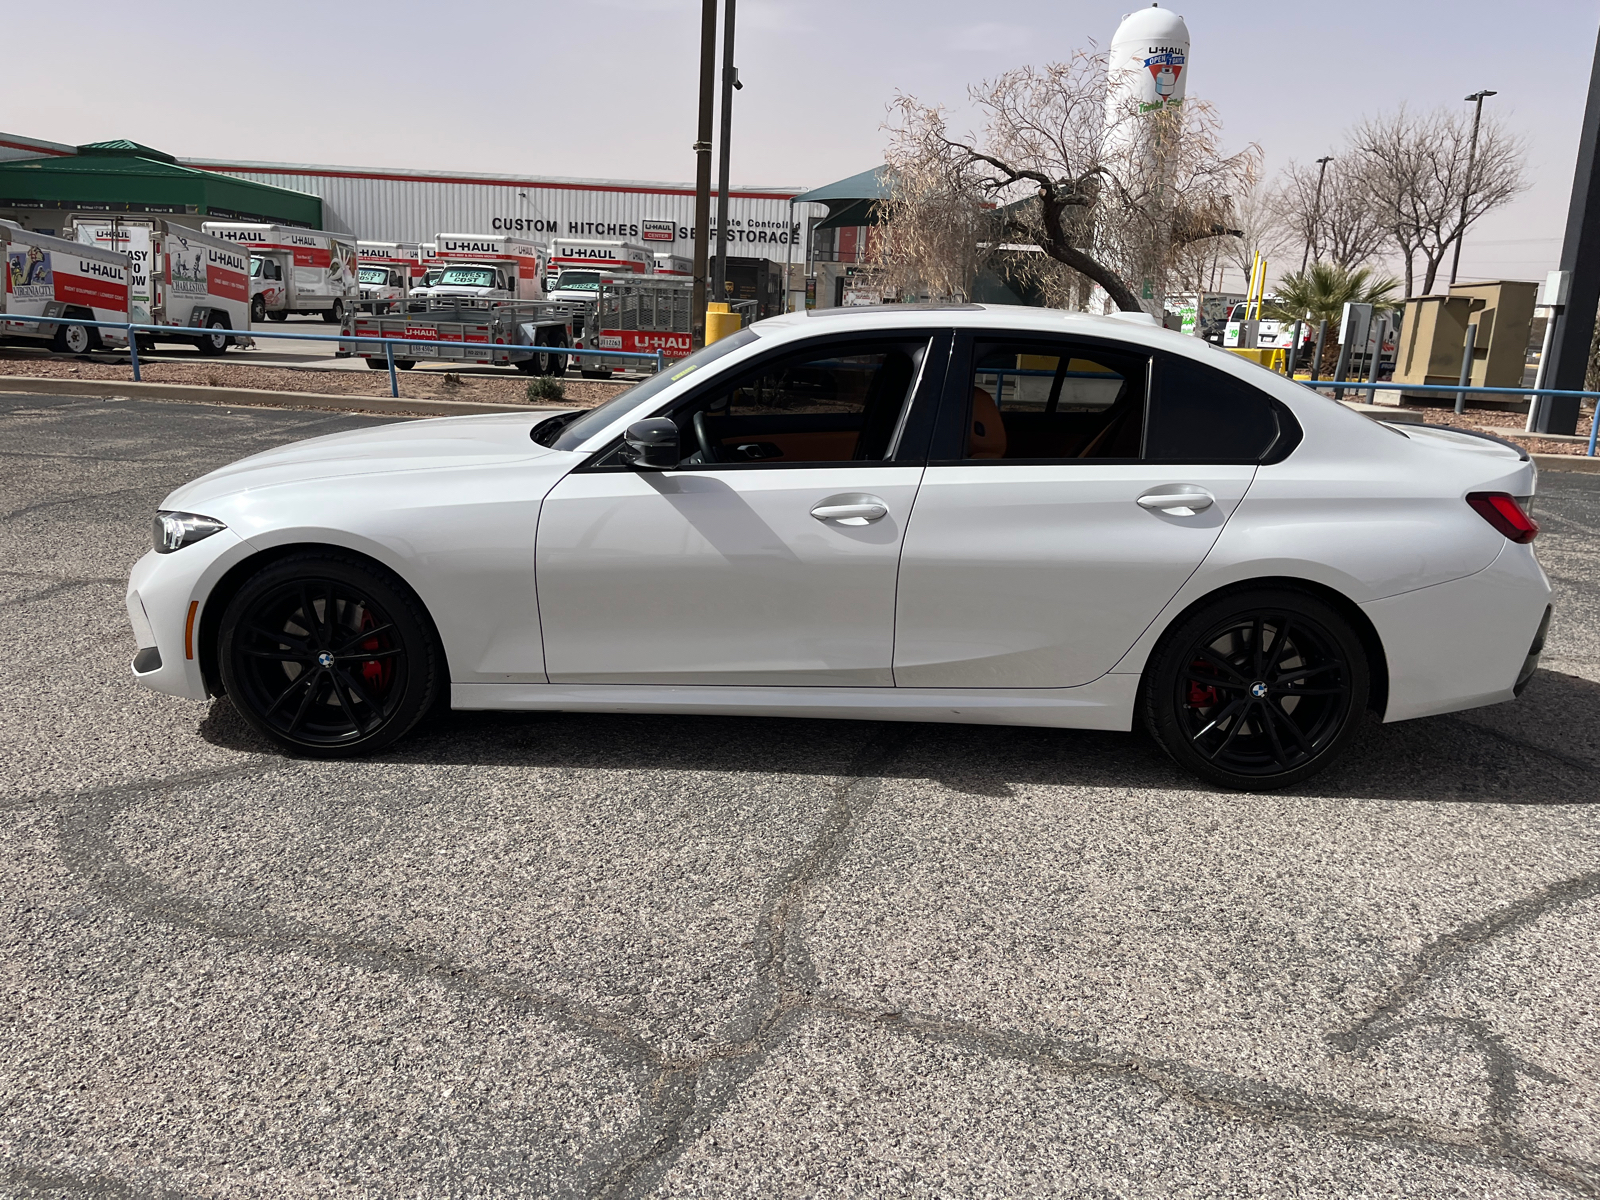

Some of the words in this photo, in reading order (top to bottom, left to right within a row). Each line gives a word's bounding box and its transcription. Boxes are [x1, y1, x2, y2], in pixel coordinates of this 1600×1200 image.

[1149, 47, 1184, 55] U-HAUL
[1150, 55, 1166, 64] OPEN
[492, 218, 557, 233] CUSTOM
[569, 222, 638, 236] HITCHES
[747, 219, 800, 229] Controlld
[291, 235, 316, 246] U-HAUL
[679, 227, 718, 240] SEF
[727, 229, 799, 244] STORAGE
[446, 242, 499, 252] U-HAUL
[359, 249, 392, 257] -HAUL
[562, 248, 616, 259] U-HAUL
[209, 250, 244, 270] U-HAUL
[80, 261, 124, 280] U-HAUL
[13, 286, 40, 297] VIRGINIA
[40, 285, 53, 296] CITY
[172, 281, 206, 292] CHARLESTON
[635, 336, 690, 349] U-HAU
